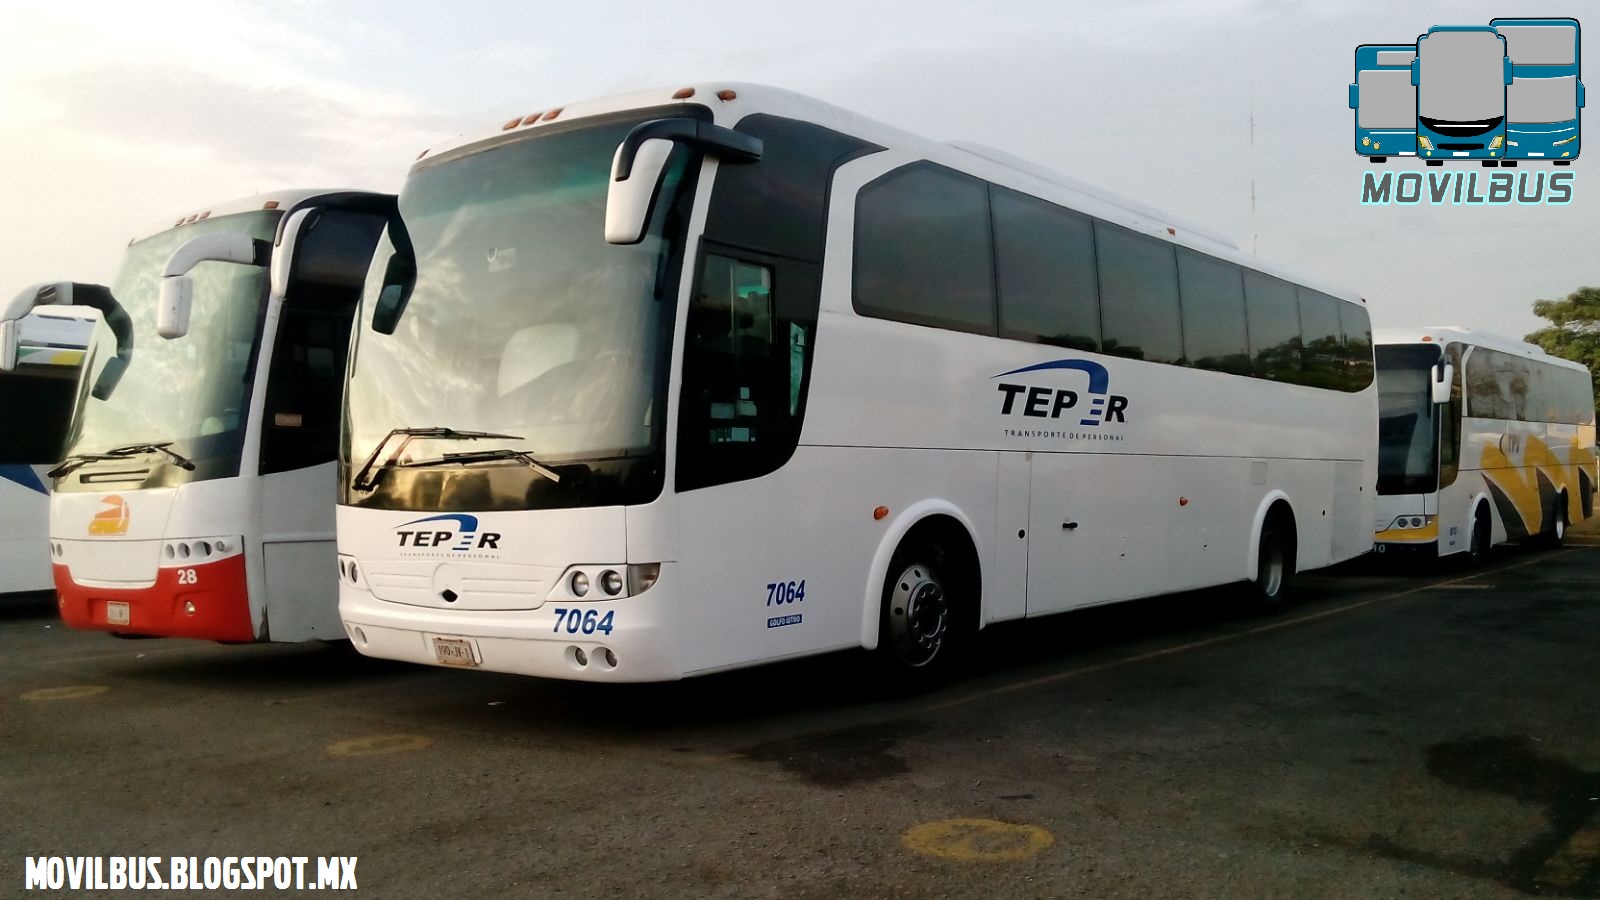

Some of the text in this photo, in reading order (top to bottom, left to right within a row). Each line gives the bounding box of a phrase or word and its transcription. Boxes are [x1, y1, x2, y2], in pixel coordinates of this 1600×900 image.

[1004, 429, 1066, 439] TRANSPORTE
[1082, 433, 1124, 441] PERSONAL
[177, 569, 198, 585] 28
[766, 579, 806, 607] 7064
[553, 608, 615, 635] 7064
